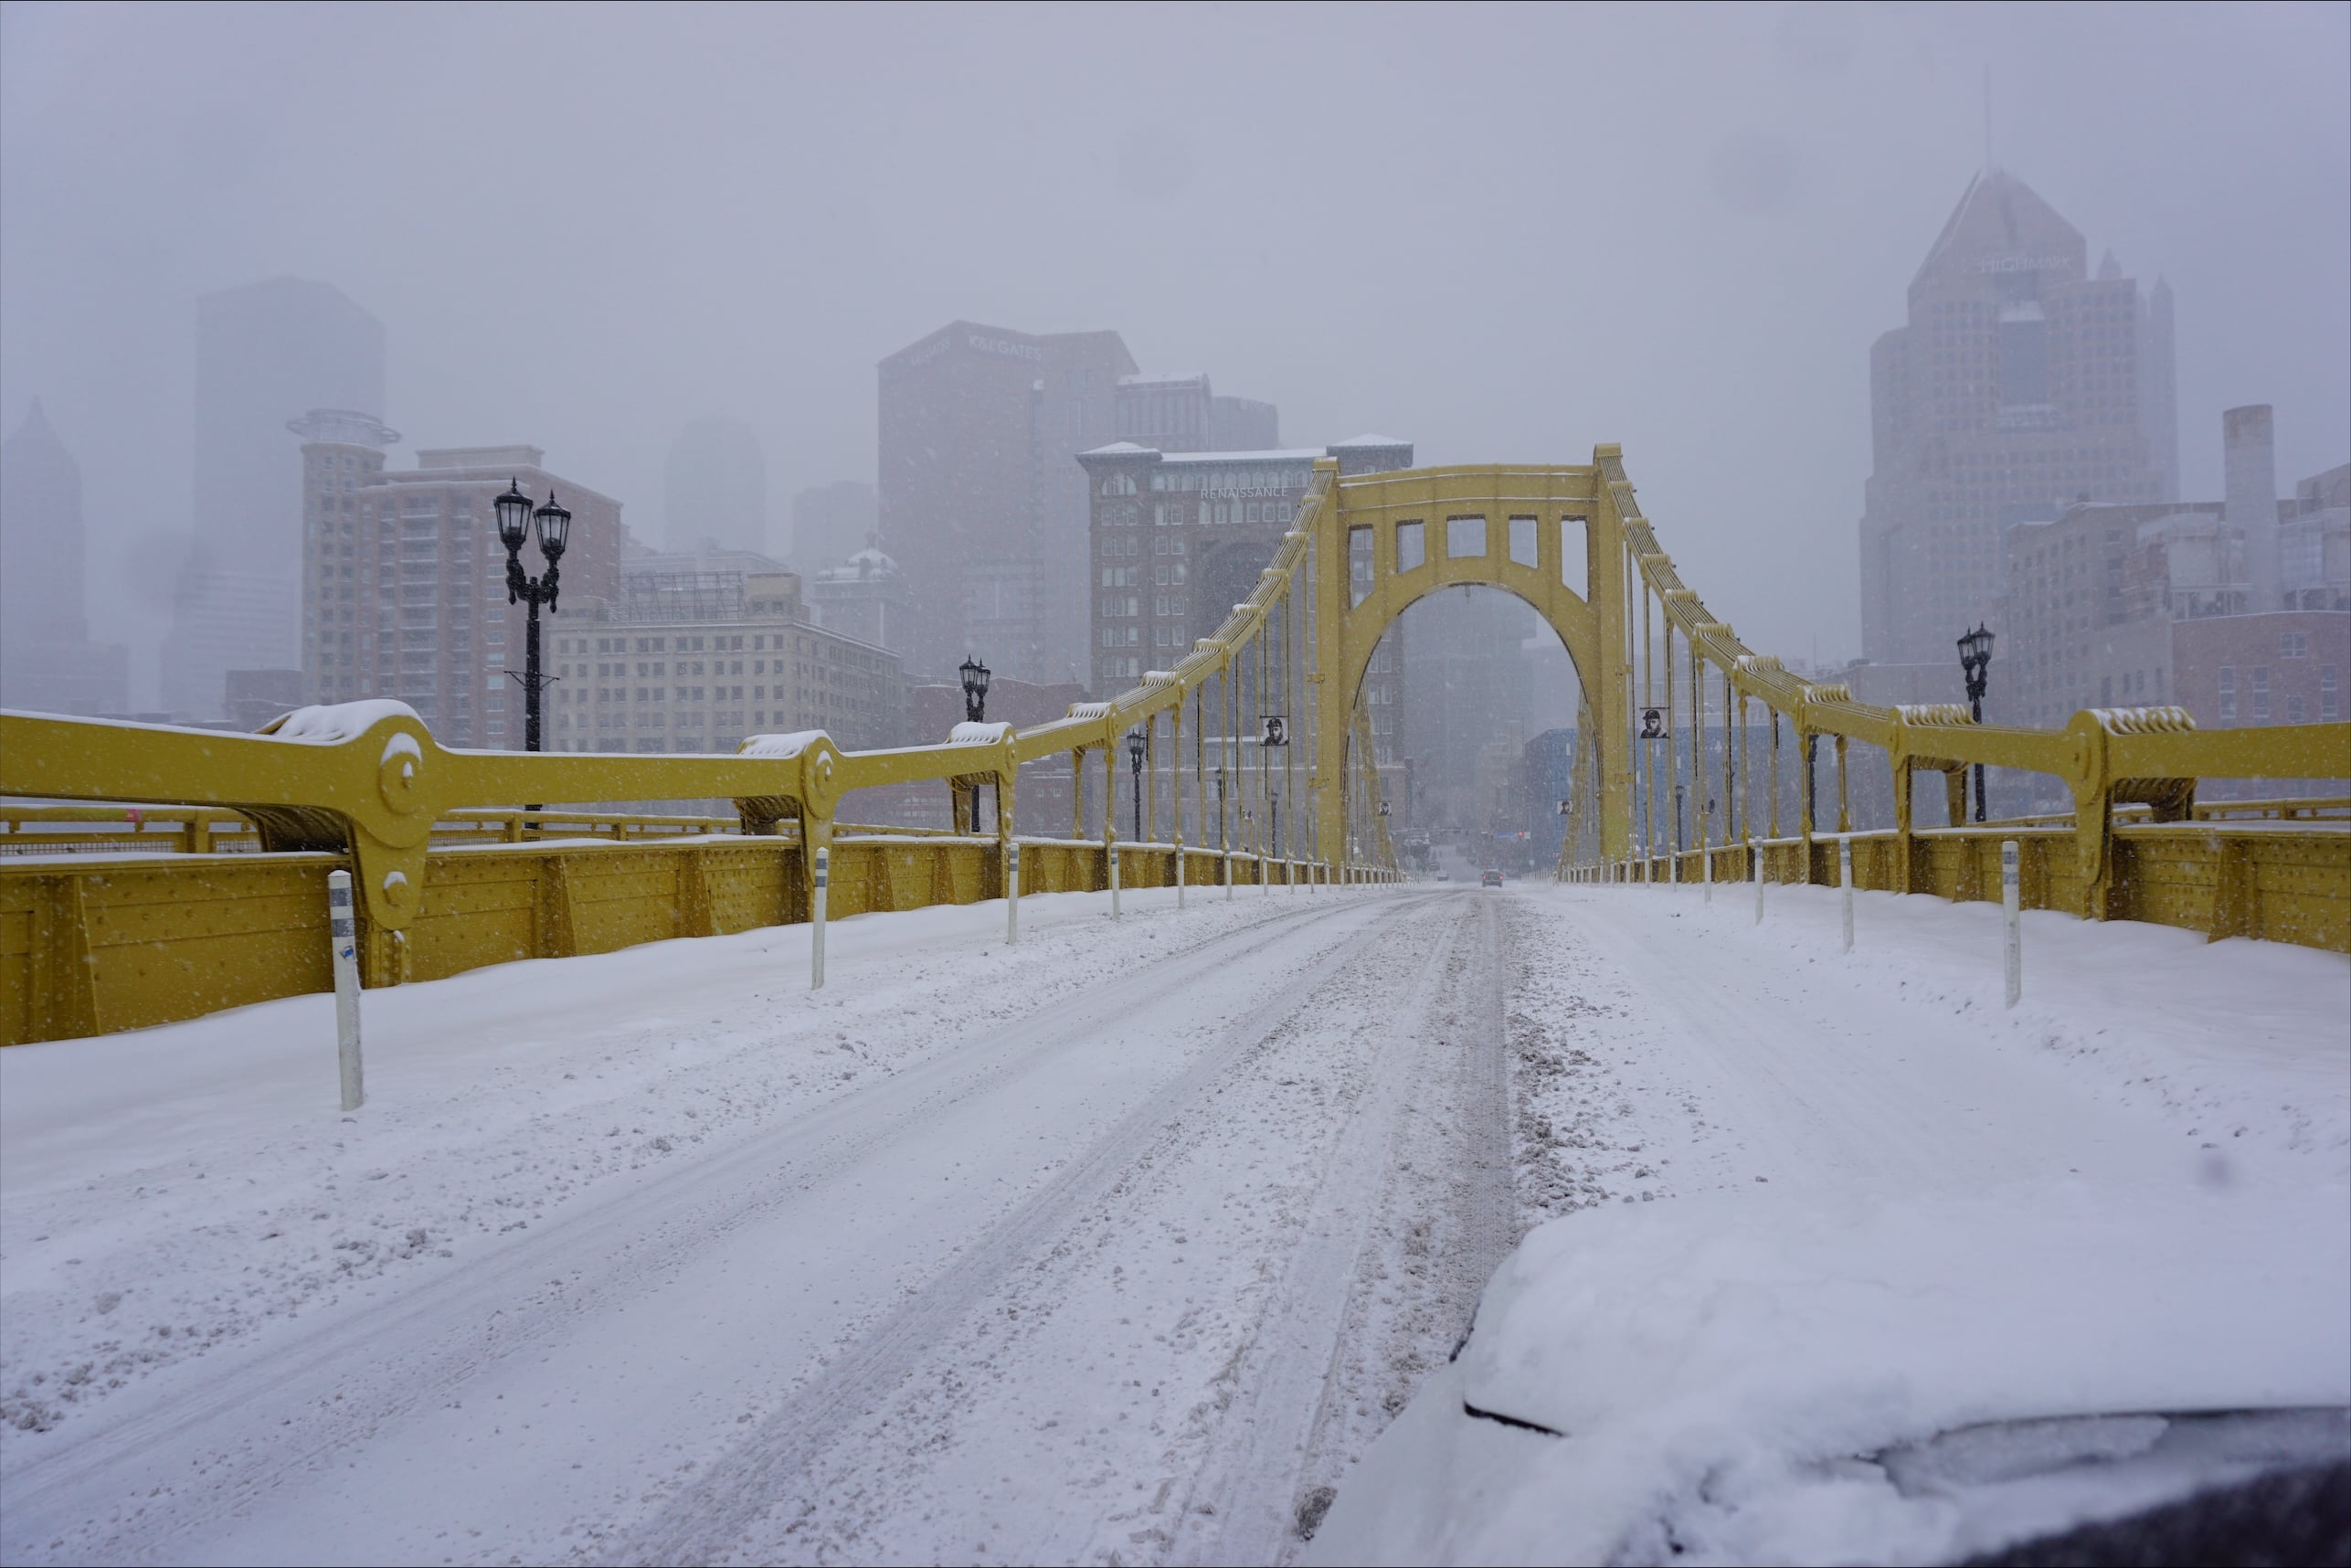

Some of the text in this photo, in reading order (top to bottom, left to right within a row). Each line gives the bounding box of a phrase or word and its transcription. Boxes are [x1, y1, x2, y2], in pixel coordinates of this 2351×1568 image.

[1981, 256, 2070, 272] HIGHMARK
[969, 335, 1042, 361] K&L GATES
[1201, 487, 1287, 499] RENAISSANCE
